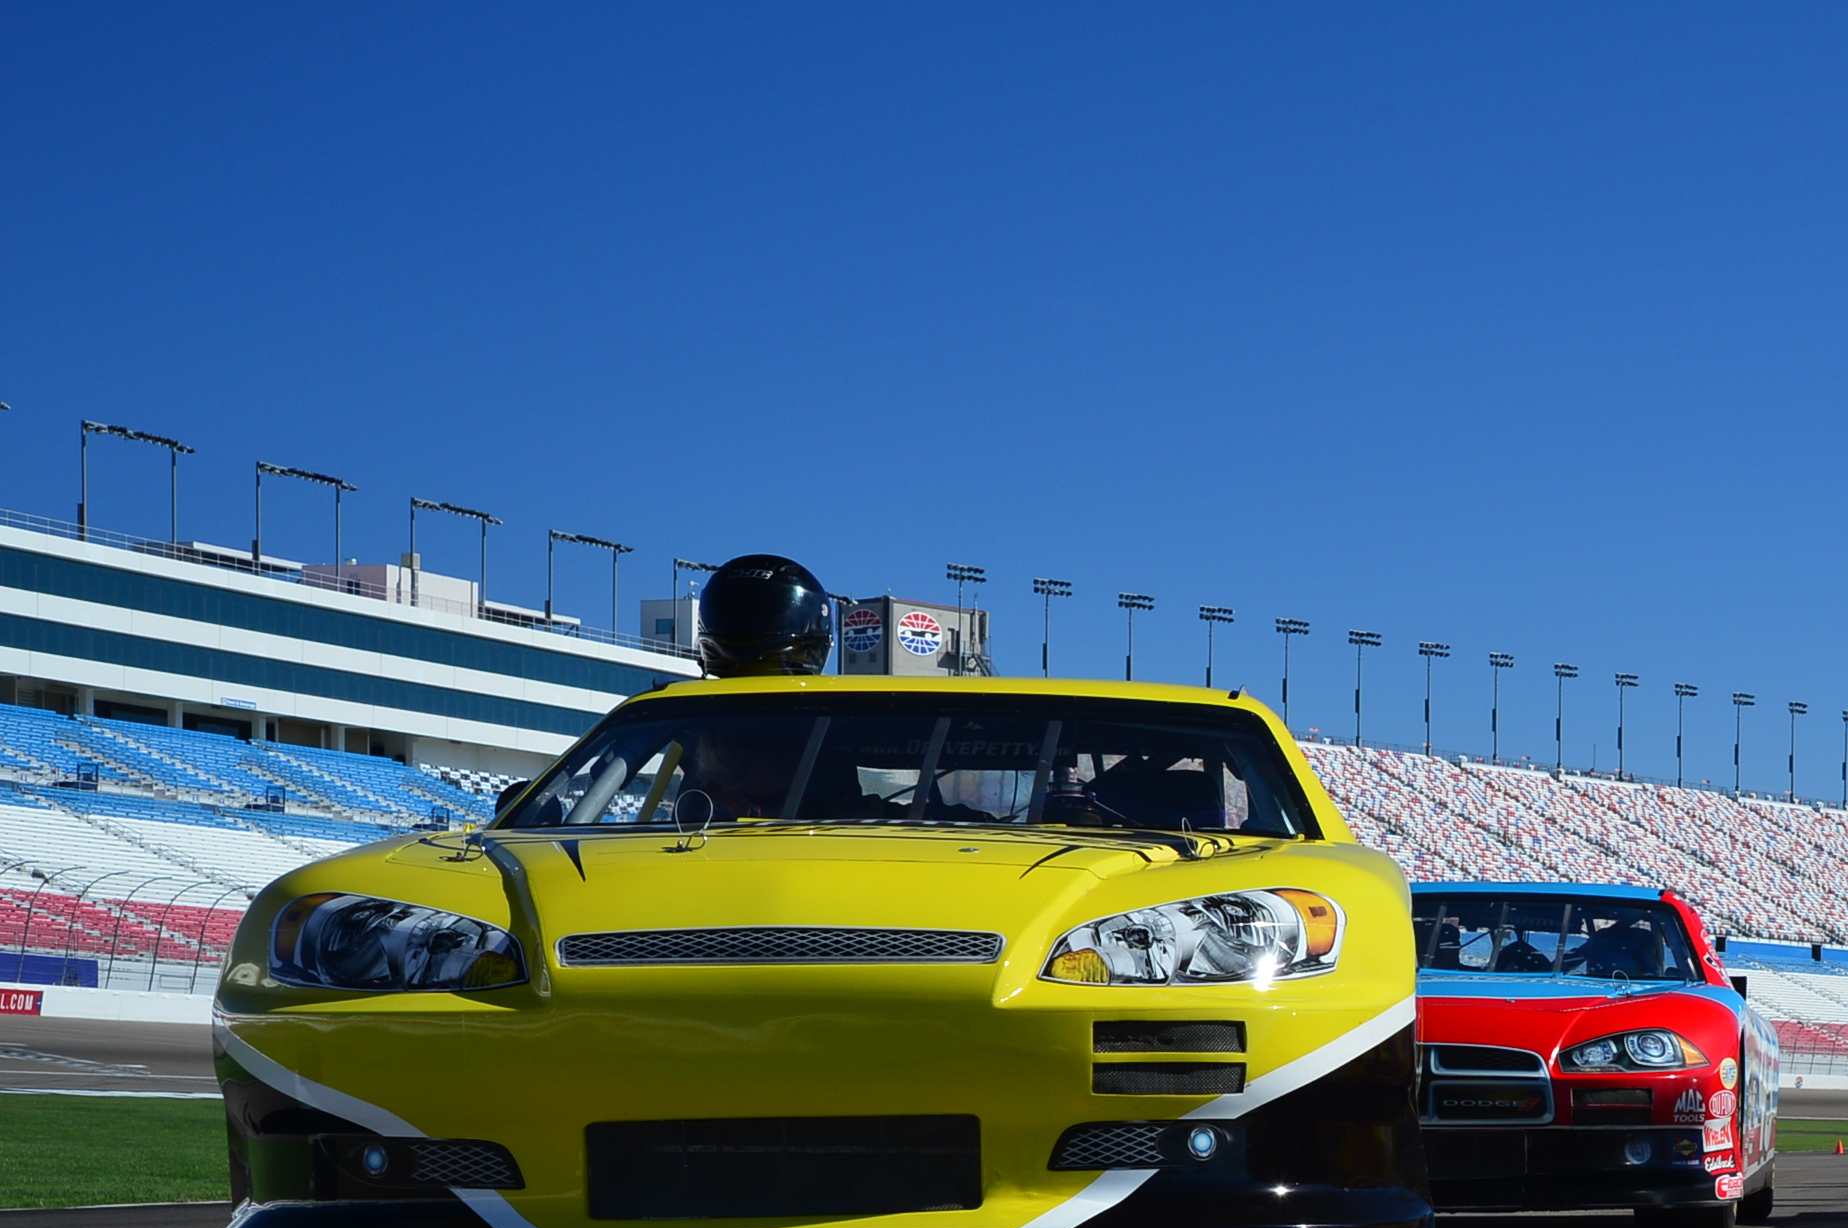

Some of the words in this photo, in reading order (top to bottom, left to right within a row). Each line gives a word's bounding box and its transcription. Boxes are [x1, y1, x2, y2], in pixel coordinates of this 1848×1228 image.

[1443, 1099, 1527, 1108] DODGE
[1673, 1088, 1706, 1113] MAC
[1673, 1114, 1706, 1123] TOOLS
[1704, 1124, 1731, 1148] WHELEN
